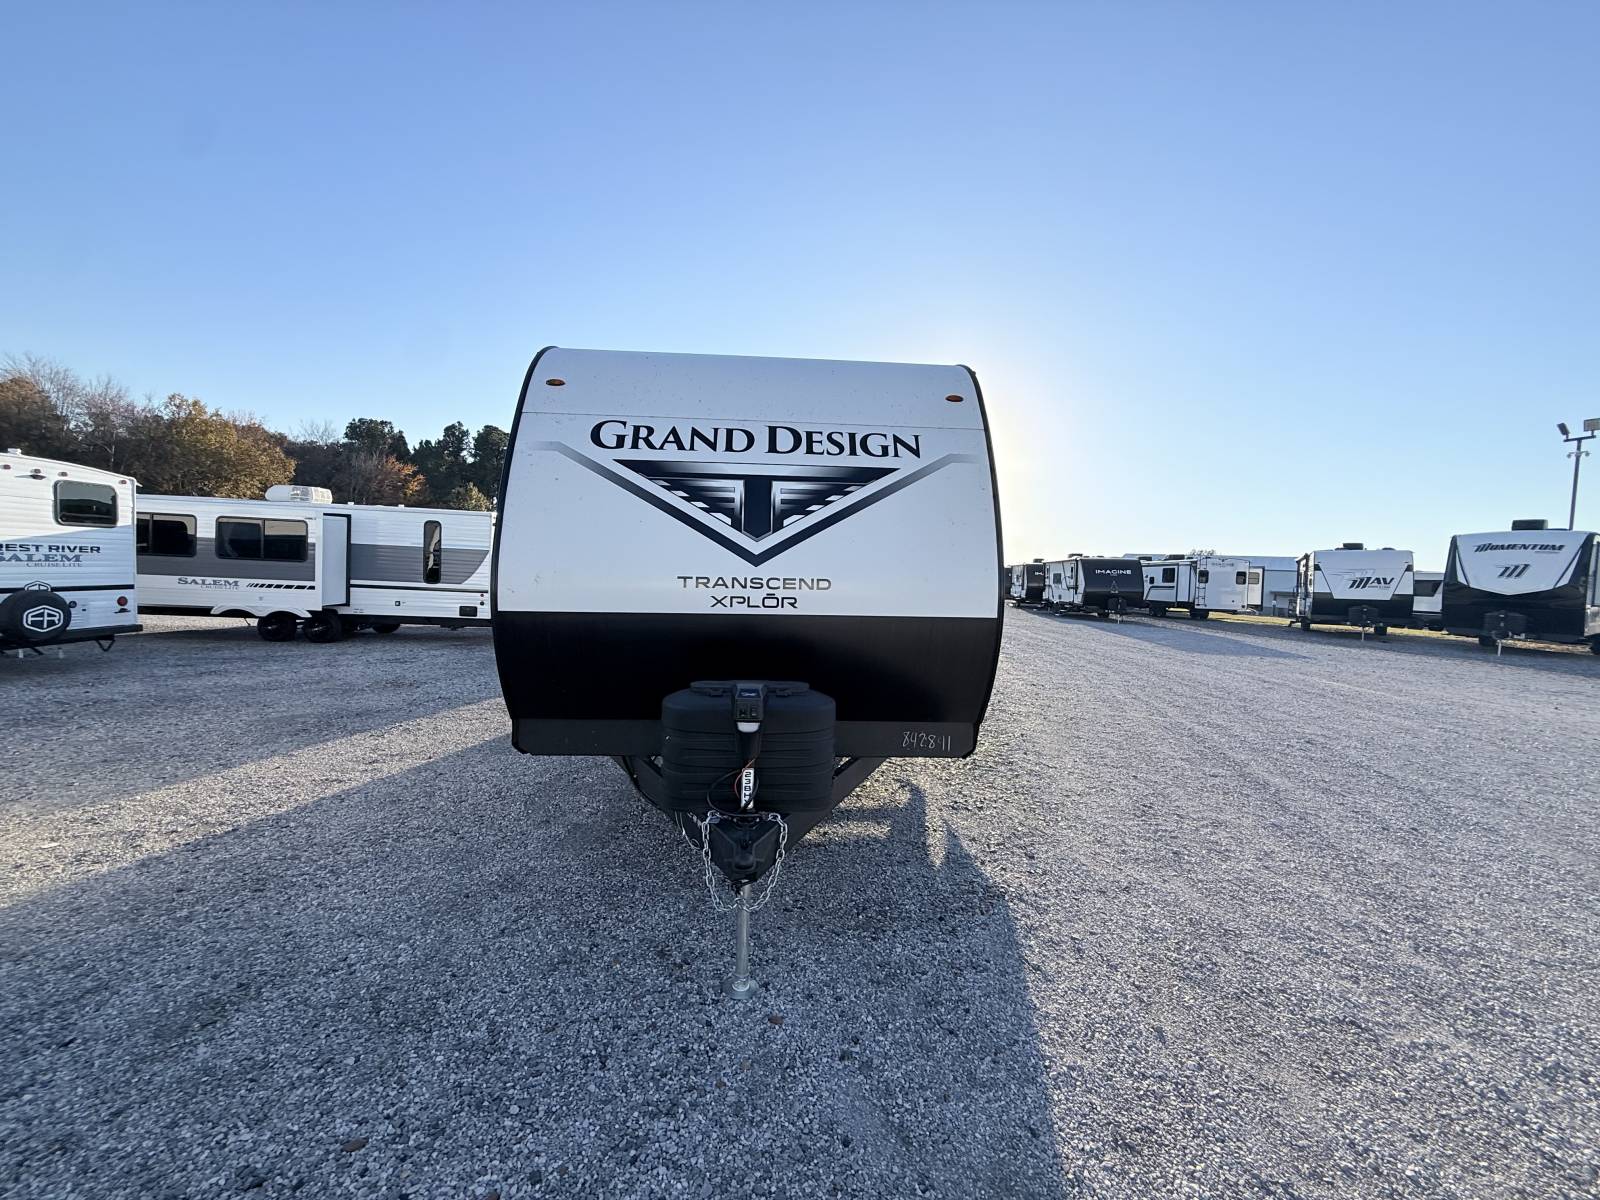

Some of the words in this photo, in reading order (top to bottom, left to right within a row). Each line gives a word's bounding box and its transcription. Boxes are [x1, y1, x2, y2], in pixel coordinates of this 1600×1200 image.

[590, 420, 755, 453] GRAND
[764, 425, 921, 459] DESIGN
[0, 543, 43, 552] EST
[48, 544, 101, 554] RIVER
[177, 576, 240, 587] SALEM
[677, 575, 832, 591] TRANSCEND
